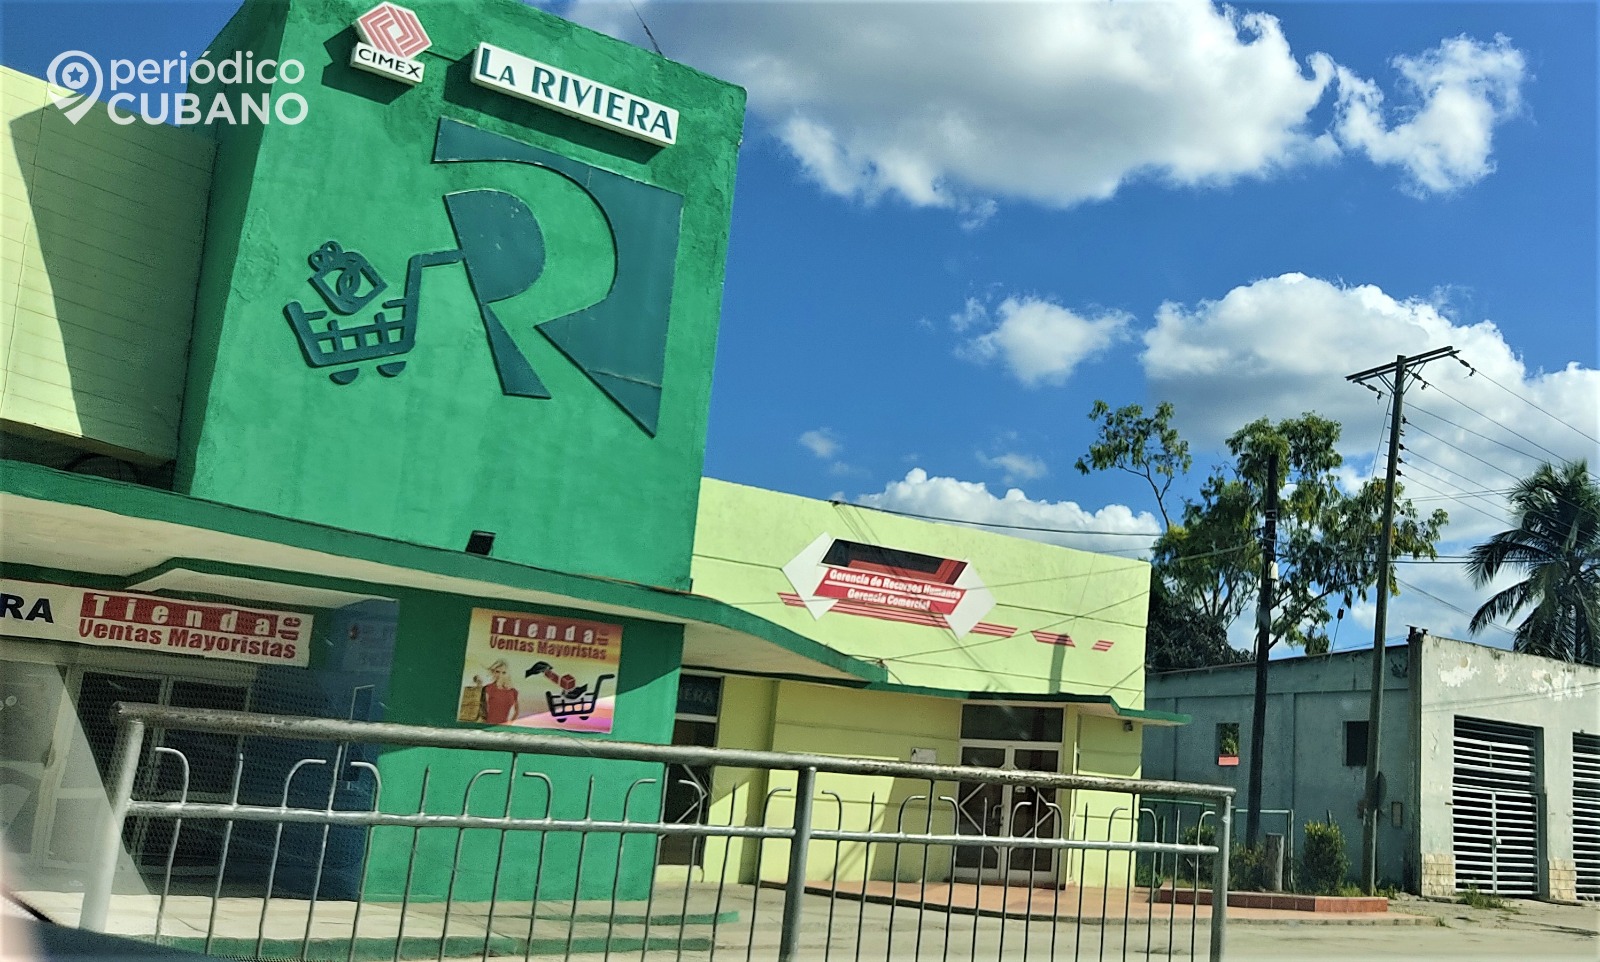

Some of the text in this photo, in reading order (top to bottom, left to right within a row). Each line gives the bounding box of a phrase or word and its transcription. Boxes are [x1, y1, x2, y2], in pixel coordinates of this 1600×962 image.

[358, 48, 421, 79] CIMEX
[531, 66, 673, 139] RIVIERA
[829, 569, 962, 599] Gerencia de Recursos Humanos
[847, 588, 931, 610] Gerencia Comercial
[92, 594, 273, 636] Tienda
[496, 617, 595, 643] Tienda
[79, 618, 296, 660] Ventas Mayoristas
[490, 634, 607, 660] Ventas Mayoristas
